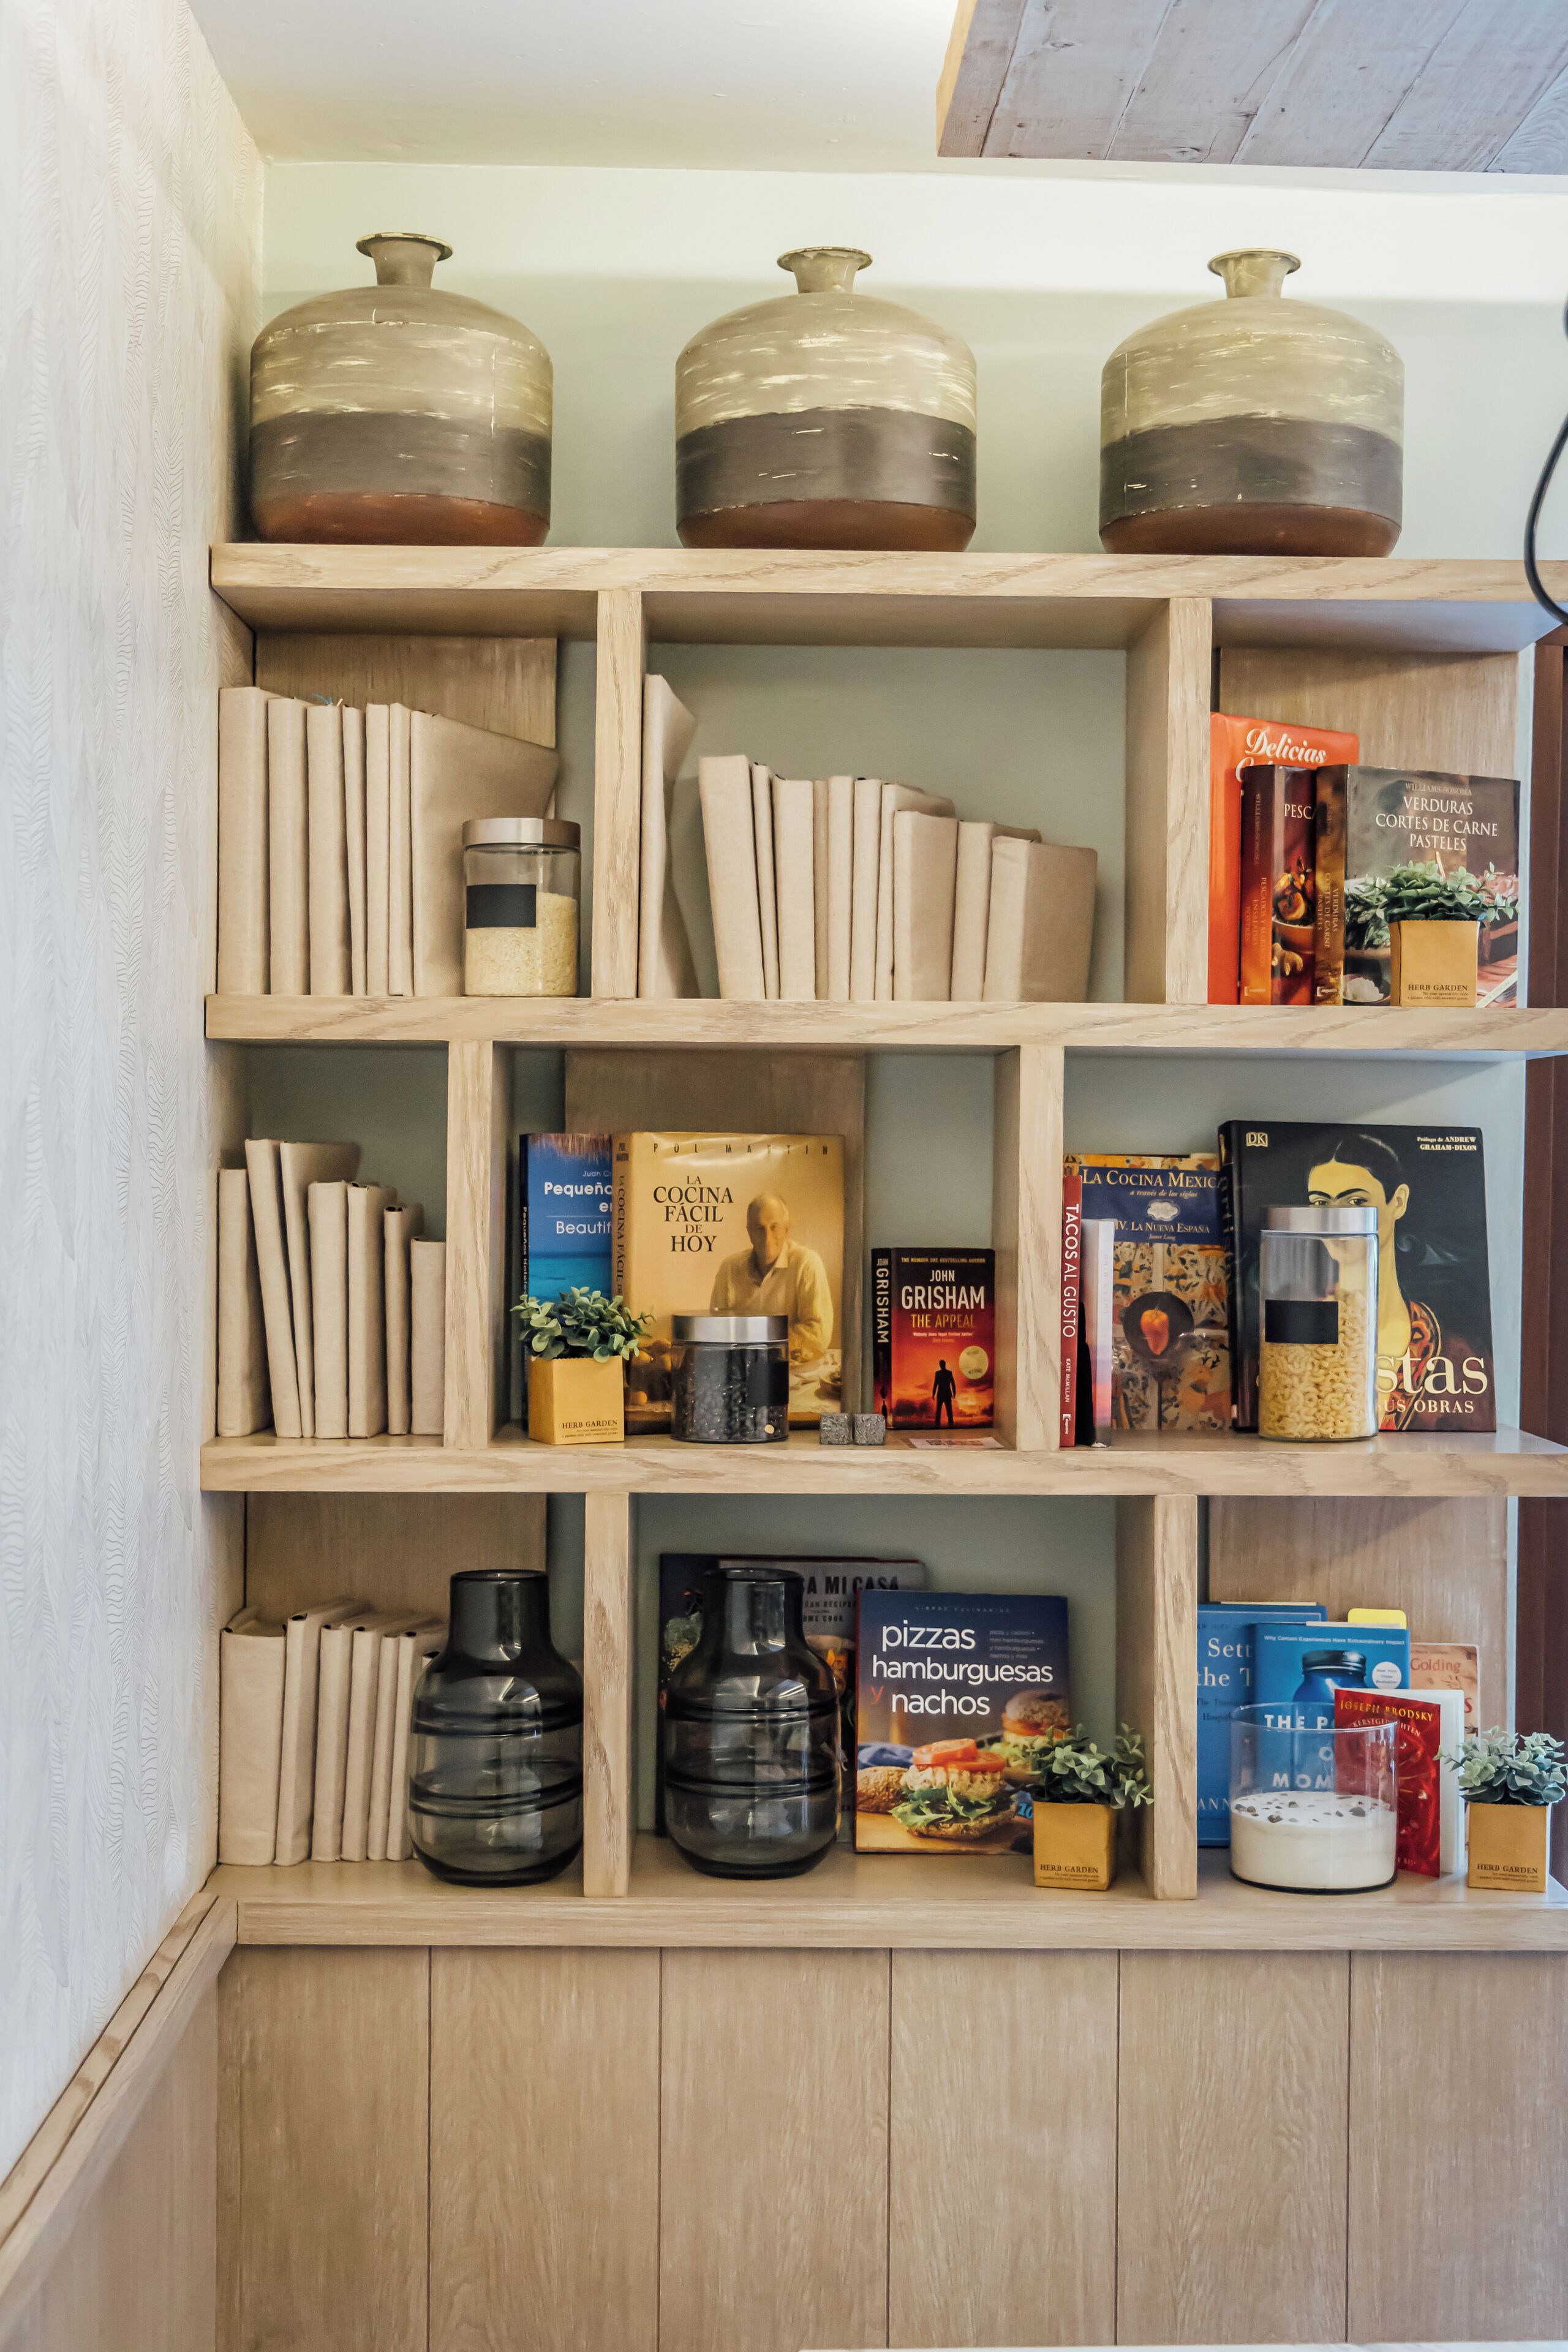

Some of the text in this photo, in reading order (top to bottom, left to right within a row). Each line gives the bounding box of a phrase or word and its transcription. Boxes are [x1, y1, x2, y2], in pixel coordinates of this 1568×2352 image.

[1245, 728, 1327, 764] Delicias
[1405, 782, 1472, 796] WILLIAMS-SONOMA
[1403, 796, 1474, 815] VERDURAS
[1375, 813, 1498, 837] CORTES DE CARNE
[1409, 833, 1467, 851] PASTELES
[1248, 1133, 1267, 1144] DK
[654, 1143, 828, 1155] POL MARTIN
[687, 1175, 702, 1185] LA
[1082, 1169, 1102, 1185] LA
[1106, 1170, 1164, 1187] COCINA
[653, 1186, 734, 1204] COCINA
[1179, 1190, 1198, 1199] siglos
[664, 1202, 724, 1223] FÁCIL
[685, 1224, 703, 1234] DE
[1131, 1221, 1143, 1232] LA
[1145, 1222, 1175, 1232] NUEVA
[1177, 1223, 1210, 1234] ESPAÑA
[671, 1235, 717, 1252] HOY
[617, 1244, 625, 1282] FÁCIL
[1062, 1203, 1079, 1338] TACOS AL GUSTO
[930, 1270, 955, 1282] JOHN
[876, 1268, 889, 1343] GRISHAM
[901, 1286, 985, 1310] GRISHAM
[911, 1314, 976, 1329] THE APPEAL
[1379, 1400, 1474, 1413] US OBRAS
[825, 1576, 847, 1594] MI
[852, 1576, 899, 1594] CASA
[882, 1619, 976, 1652] pizzas
[872, 1654, 1054, 1685] hamburguesas
[1410, 1657, 1461, 1674] Golding
[870, 1685, 990, 1716] y nachos
[1340, 1700, 1433, 1722] JOSEPH BRODSKY
[1264, 1714, 1305, 1732] THE
[1502, 1864, 1538, 1874] GARDEN
